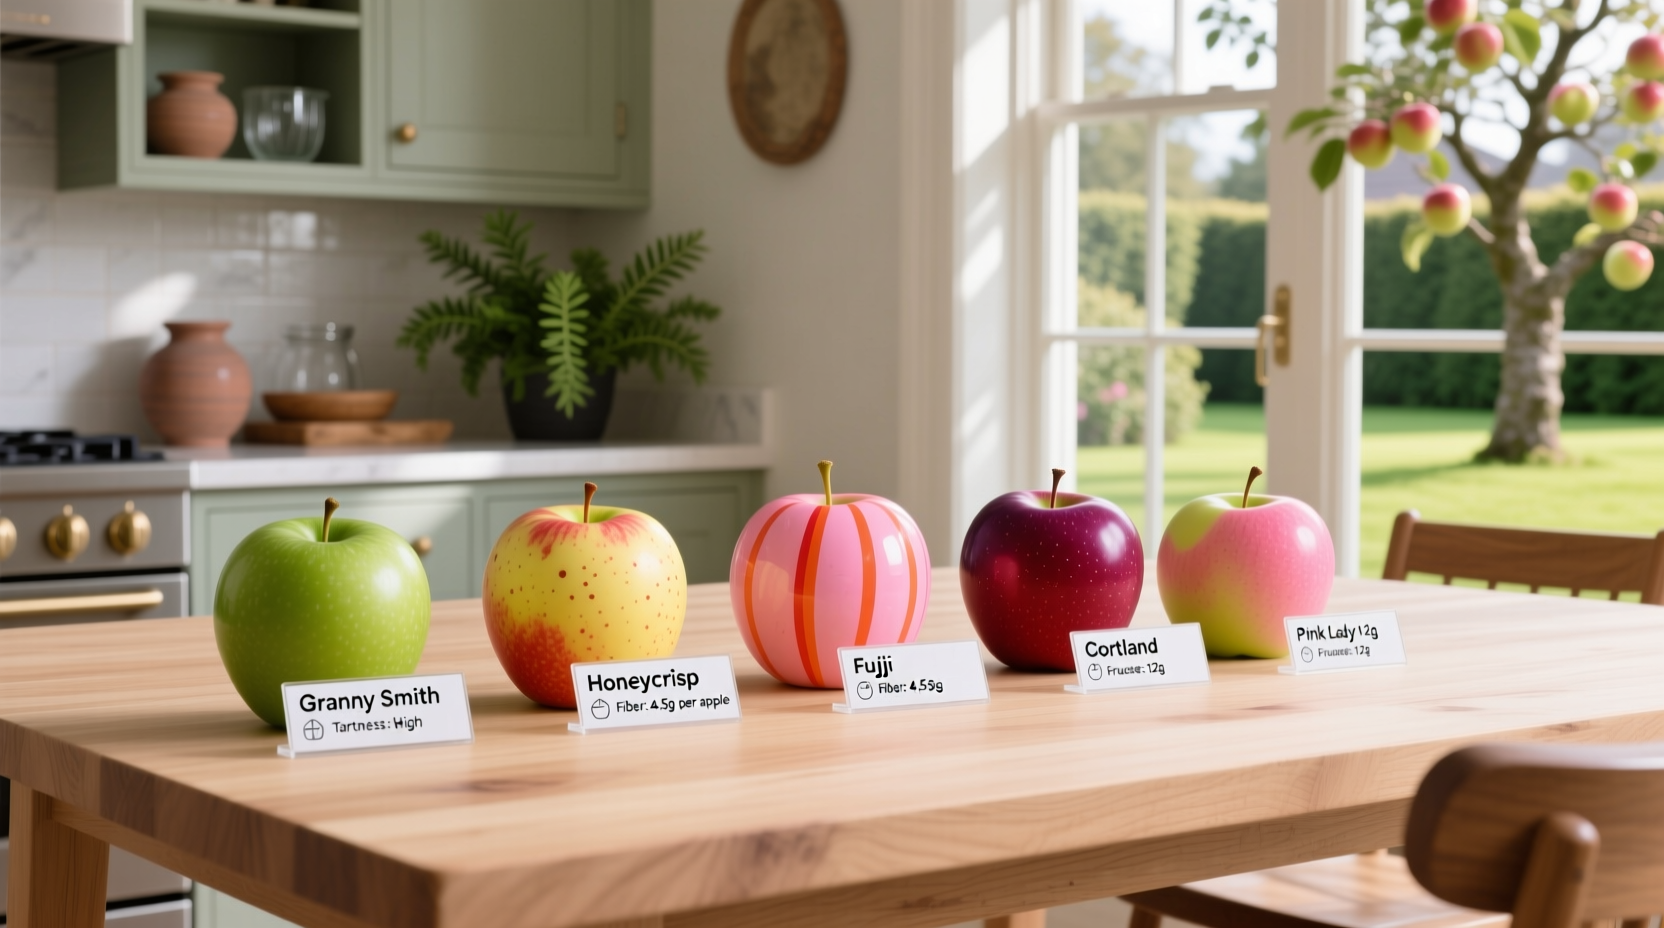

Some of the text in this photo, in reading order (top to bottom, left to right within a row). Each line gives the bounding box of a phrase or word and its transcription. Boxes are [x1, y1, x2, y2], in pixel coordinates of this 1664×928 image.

[1297, 625, 1327, 641] Pink
[1085, 637, 1158, 657] Cortland
[853, 655, 893, 678] Fujji
[1147, 662, 1165, 675] 12g
[587, 668, 699, 693] Honeycrisp
[299, 685, 440, 714] Granny Smith
[679, 698, 697, 710] per
[700, 694, 730, 709] apple
[393, 715, 423, 732] High
